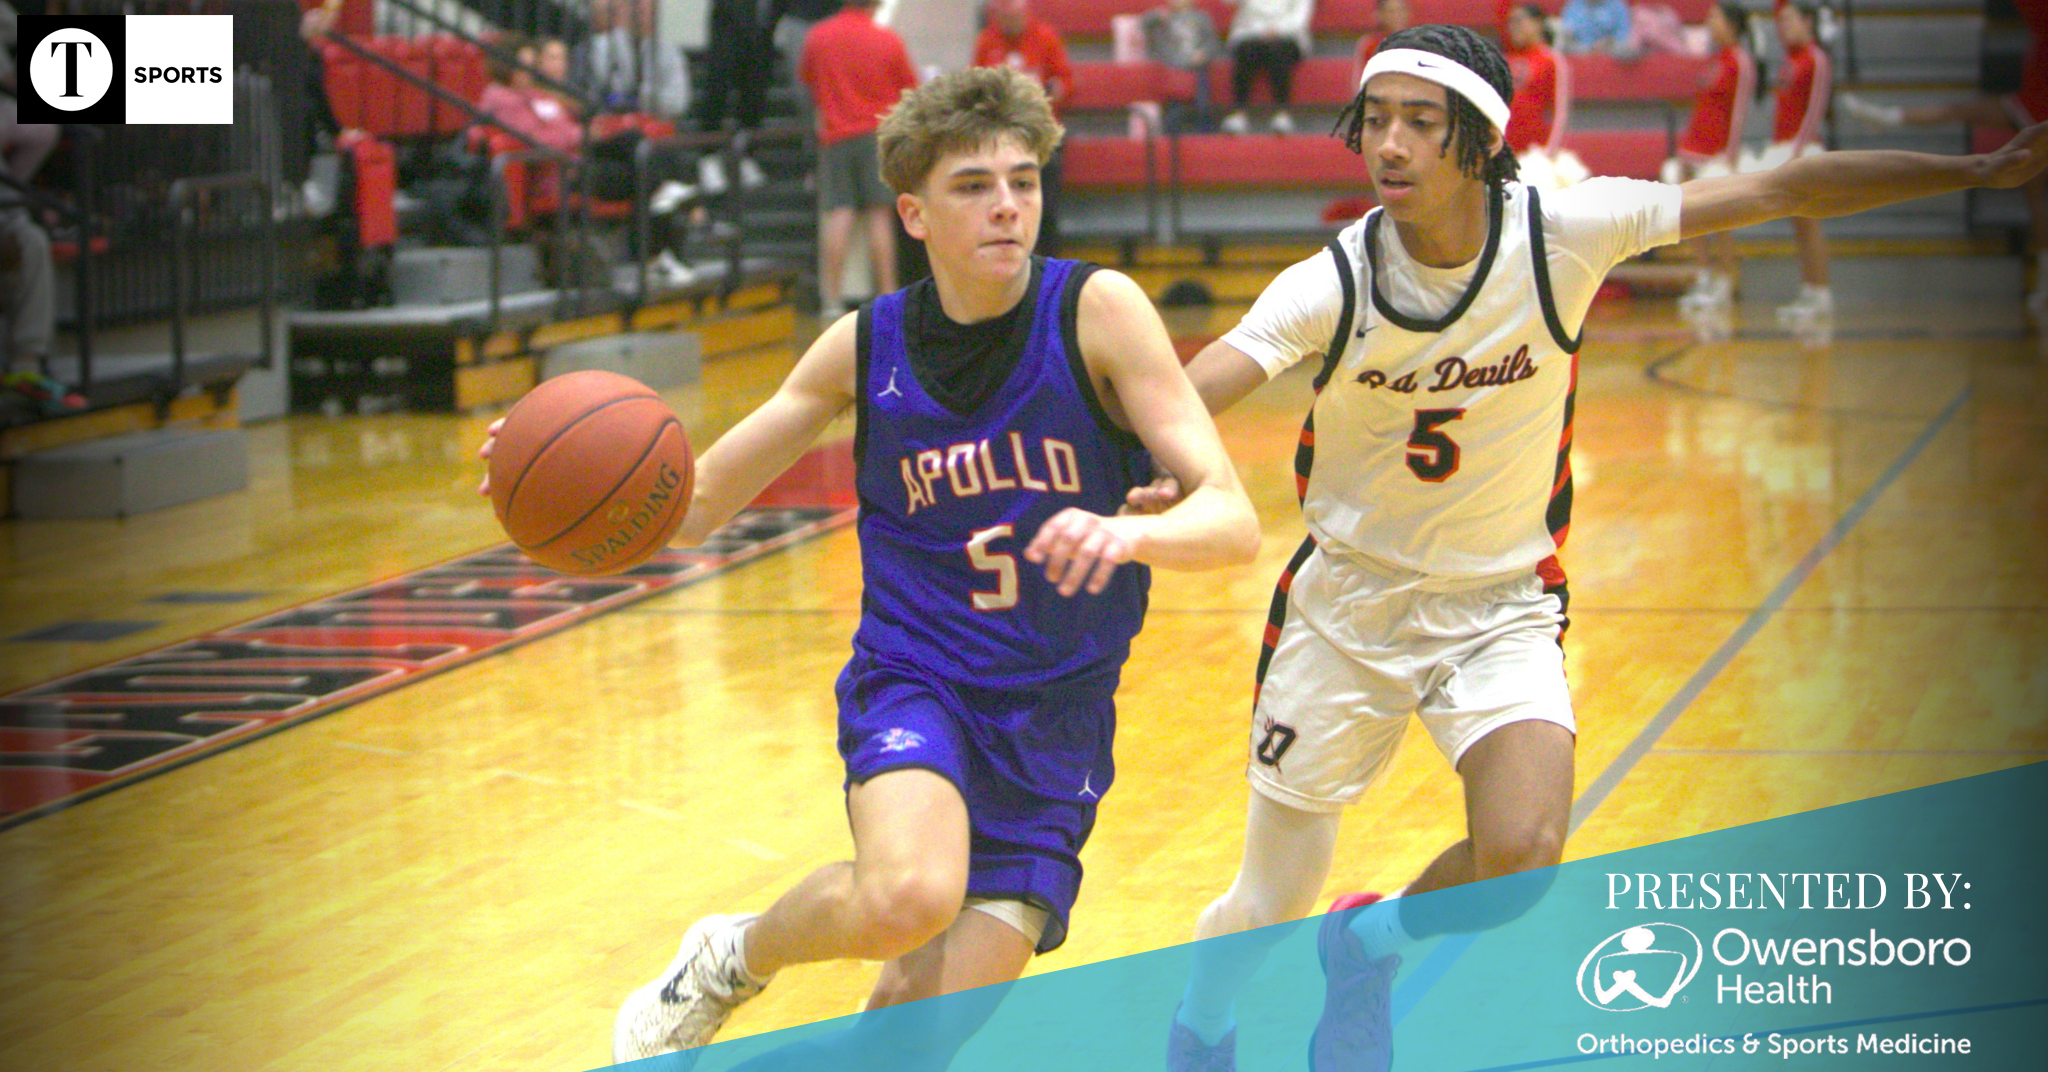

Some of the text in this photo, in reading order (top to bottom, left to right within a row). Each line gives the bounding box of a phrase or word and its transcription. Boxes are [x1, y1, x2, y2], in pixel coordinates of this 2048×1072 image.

[1427, 343, 1539, 393] Devils
[900, 432, 1081, 516] APOLLO
[1406, 408, 1467, 483] 5
[570, 462, 681, 567] SPALDING
[966, 524, 1020, 612] 5
